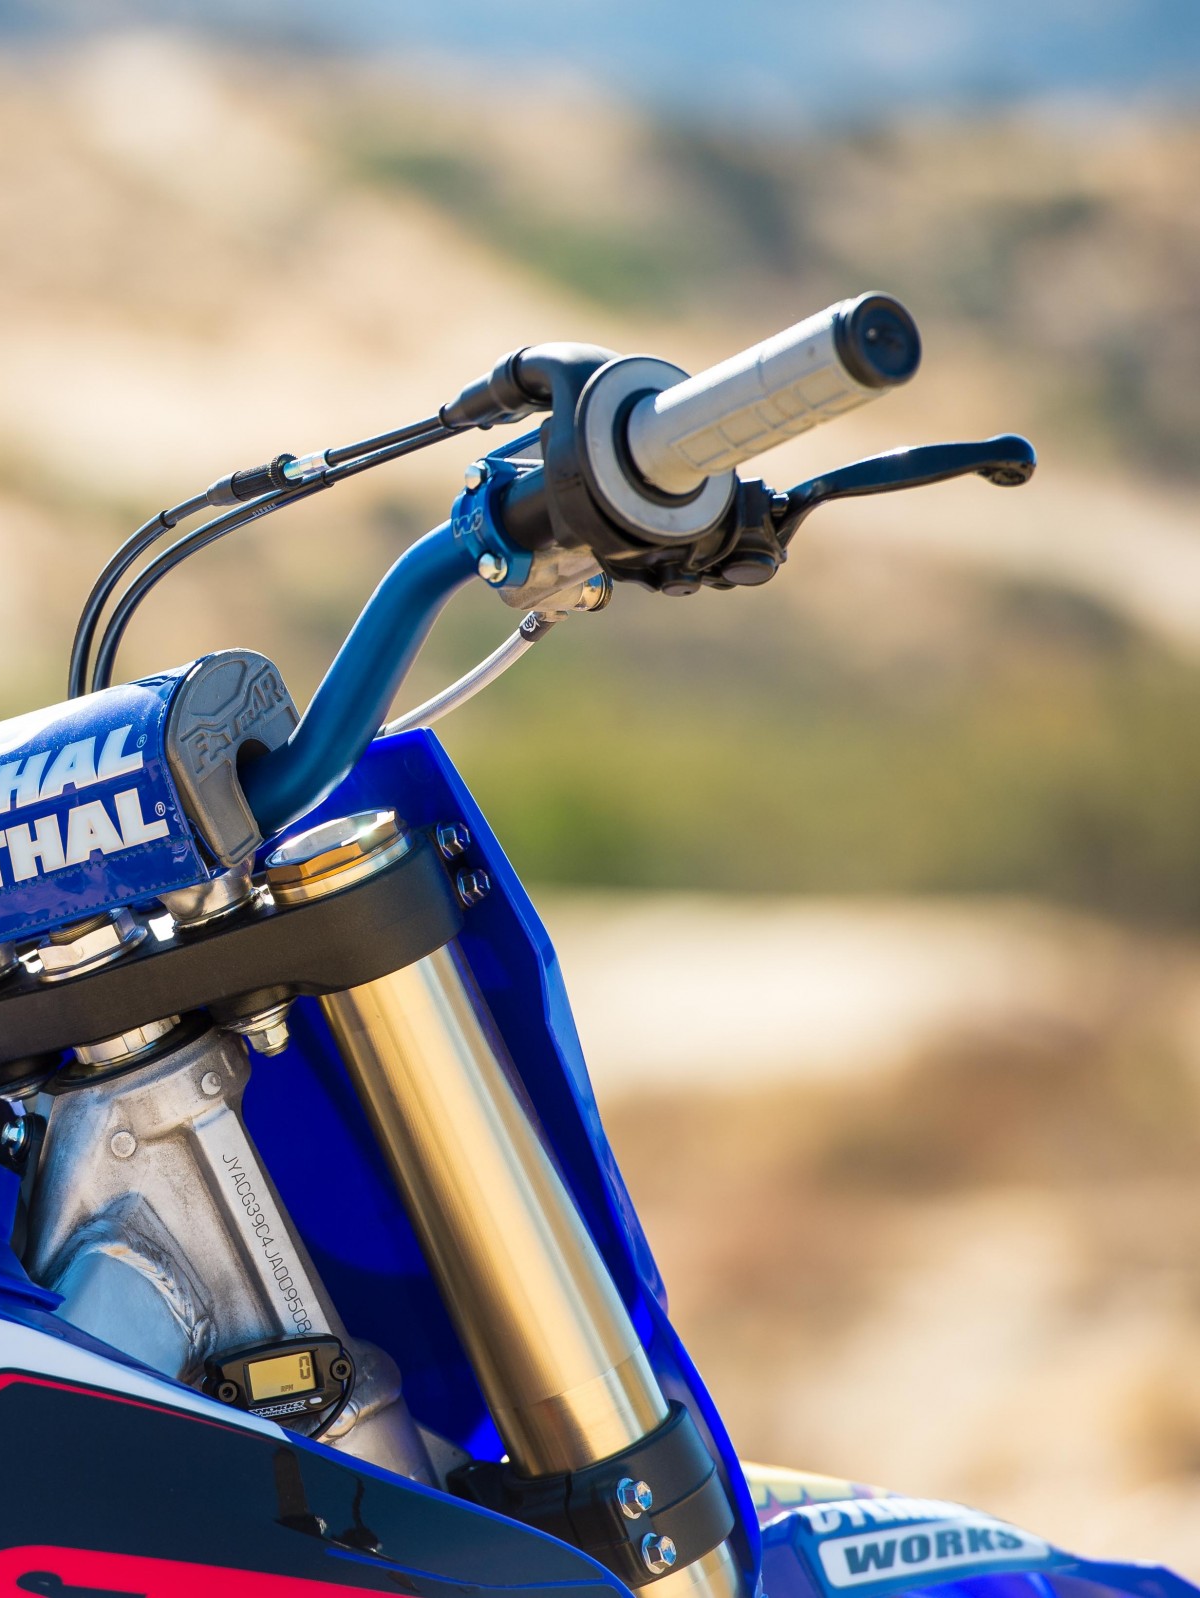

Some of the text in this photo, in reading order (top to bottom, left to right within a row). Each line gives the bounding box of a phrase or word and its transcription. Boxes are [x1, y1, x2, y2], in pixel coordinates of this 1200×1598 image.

[298, 1355, 311, 1380] 0
[280, 1383, 294, 1393] RPM
[843, 1527, 1024, 1576] WORKS
